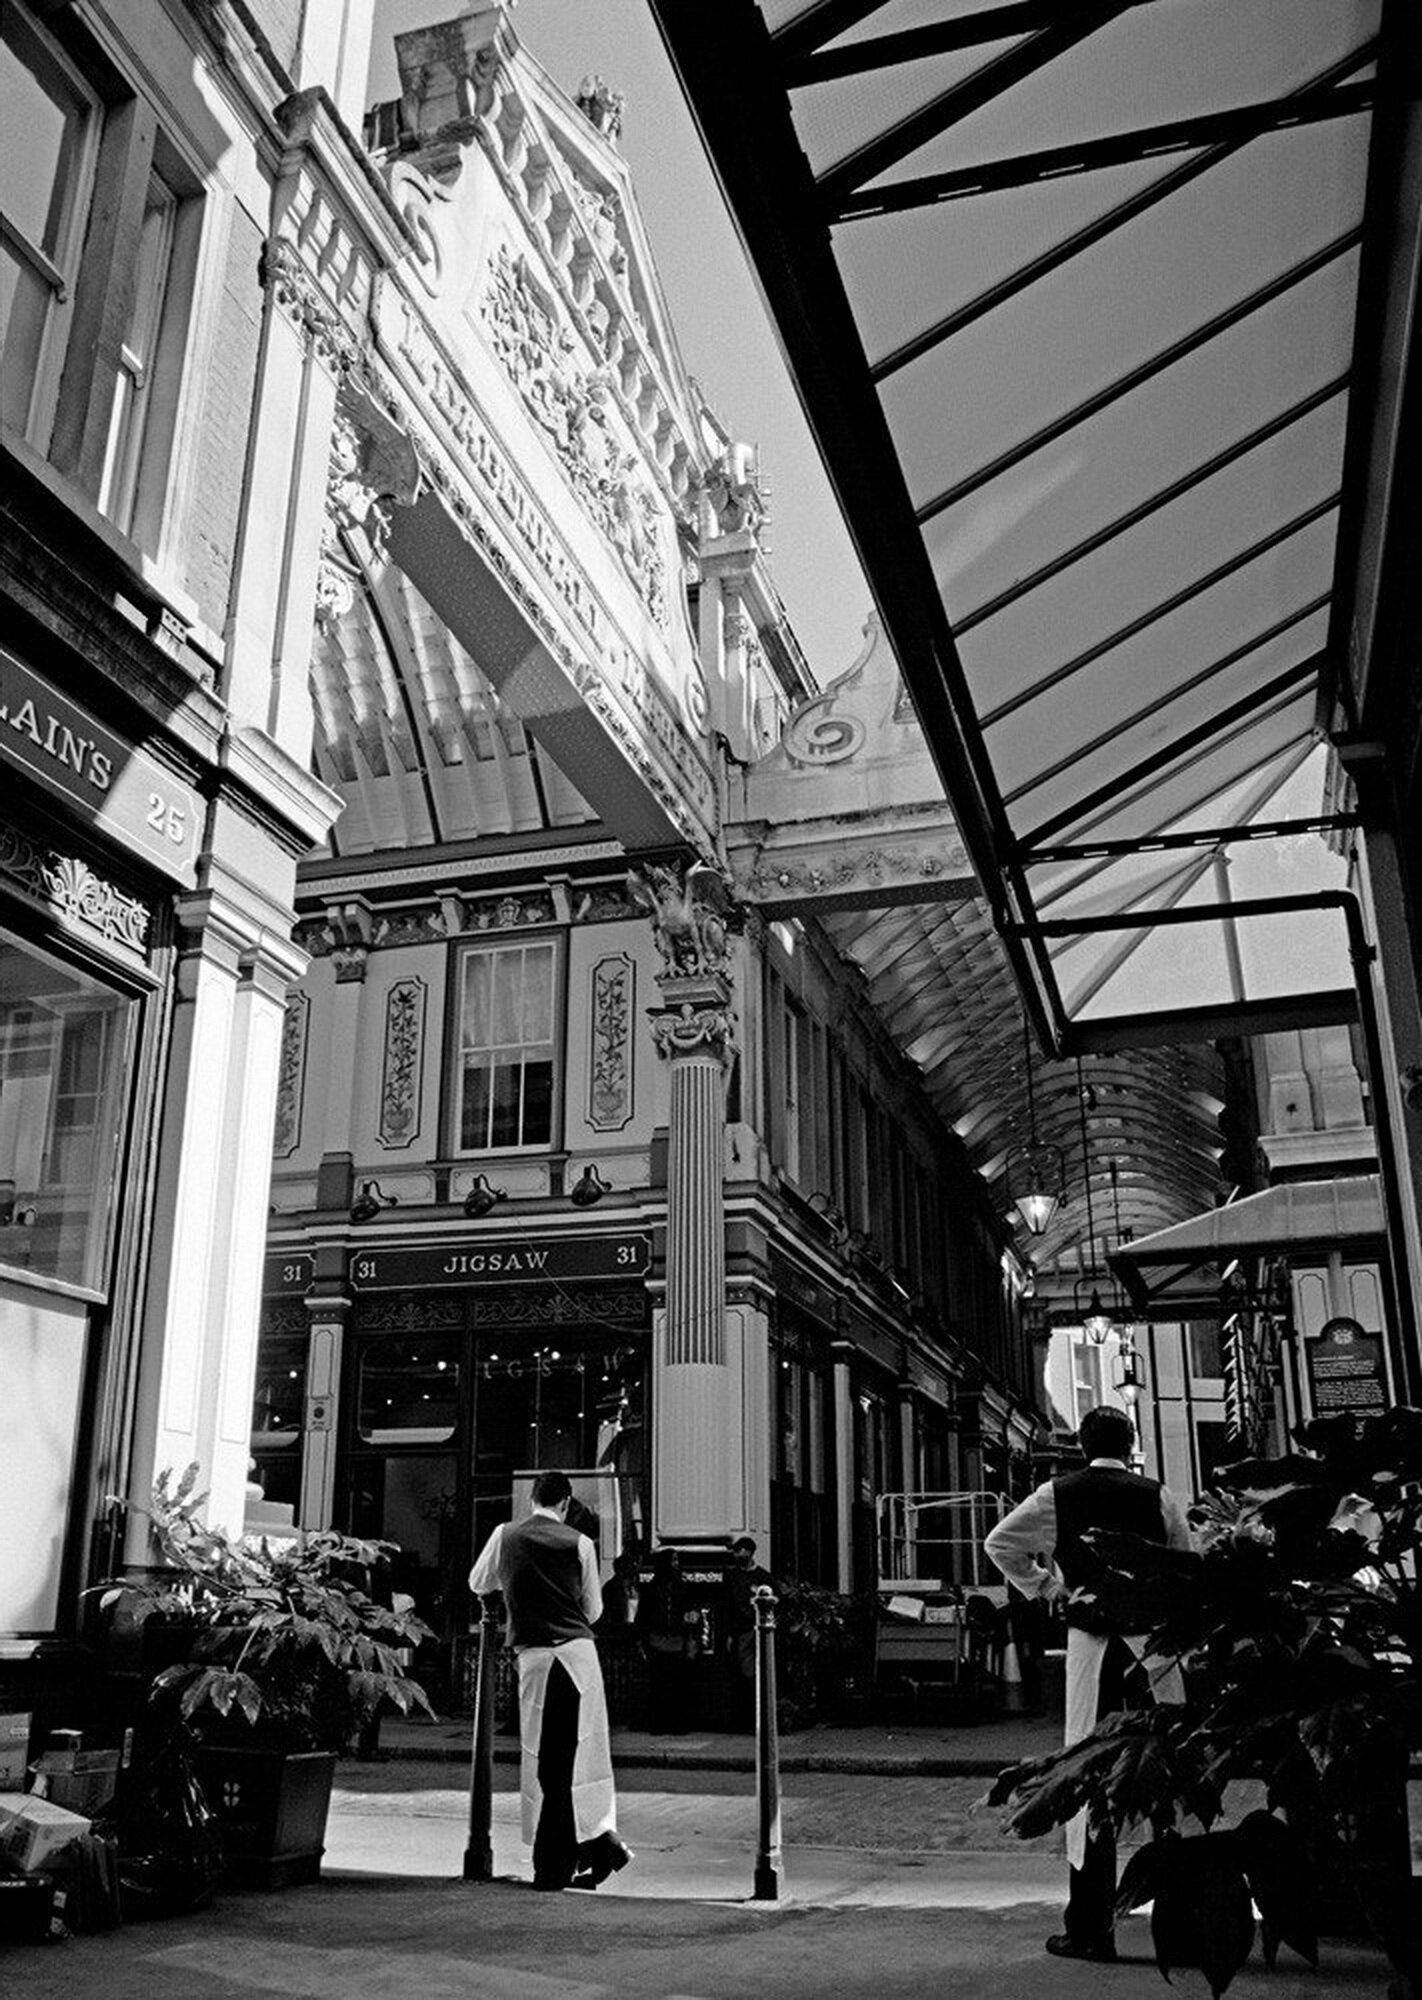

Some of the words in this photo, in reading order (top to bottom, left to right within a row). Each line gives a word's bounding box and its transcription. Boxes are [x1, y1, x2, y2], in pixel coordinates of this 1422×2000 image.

[147, 792, 185, 848] 25
[283, 1265, 302, 1282] 31
[358, 1261, 377, 1279] 31
[443, 1251, 549, 1273] JIGSAW
[617, 1246, 638, 1264] 31
